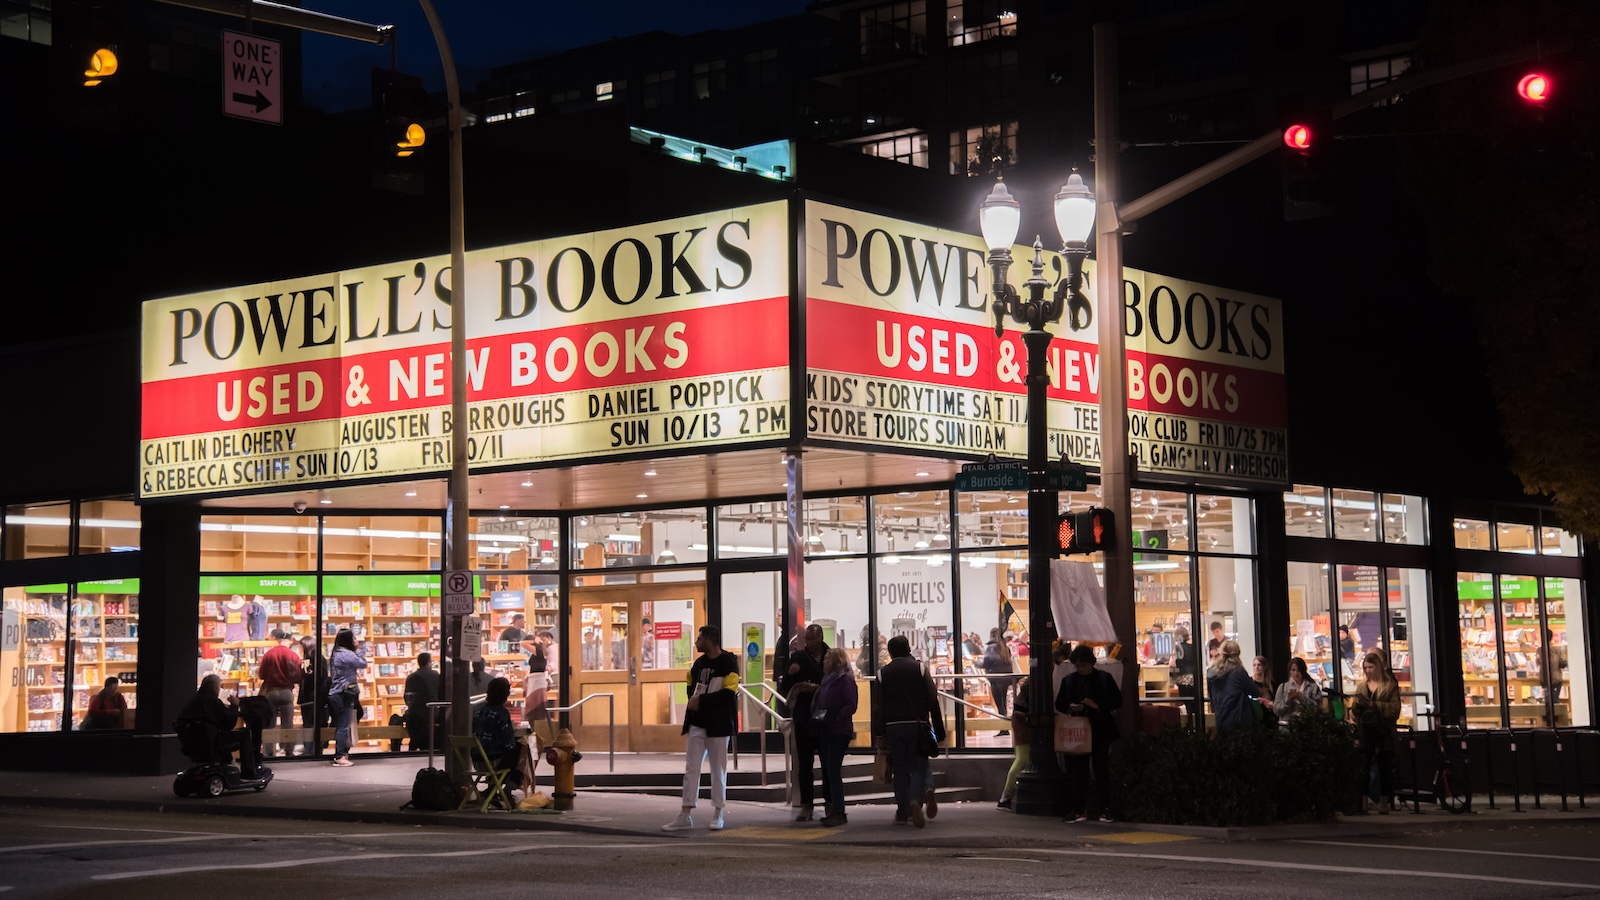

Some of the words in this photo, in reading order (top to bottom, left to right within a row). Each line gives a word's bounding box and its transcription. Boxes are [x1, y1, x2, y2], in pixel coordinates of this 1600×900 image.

[233, 39, 272, 65] ONE
[232, 61, 274, 87] WAY
[169, 261, 453, 367] POWELL'S
[495, 218, 753, 321] BOOKS
[820, 218, 1092, 330] POWE'S
[1123, 279, 1272, 360] BOOKS
[217, 371, 324, 422] USED
[345, 365, 372, 408] &
[389, 347, 490, 402] NEW
[511, 321, 689, 387] BOOKS
[876, 320, 979, 377] USED
[996, 340, 1022, 384] &
[1128, 360, 1239, 413] BOOKS
[588, 387, 659, 419] DANIEL
[670, 375, 764, 410] POPPICK
[807, 373, 858, 404] KIDS'
[867, 381, 965, 417] STORYTIME
[973, 393, 1003, 420] SAT
[341, 412, 430, 446] AUGUSTEN
[442, 397, 565, 434] BRROUGHS
[611, 419, 649, 447] SUN
[664, 412, 721, 443] 10/13
[807, 405, 867, 437] STORE
[874, 412, 929, 443] TOURS
[1074, 406, 1099, 432] TEE
[1127, 414, 1149, 438] OK
[1155, 417, 1187, 442] CLUB
[1199, 422, 1219, 446] FRI
[1223, 425, 1257, 450] 10/25
[1261, 430, 1286, 454] 7PM
[144, 440, 206, 466] CAITLIN
[213, 428, 296, 460] DELOHERY
[422, 439, 451, 466] FRI
[466, 434, 504, 460] 0/11
[1049, 432, 1100, 459] UNDEA
[1225, 452, 1287, 479] ANDERSON
[143, 471, 153, 492] &
[156, 466, 228, 492] REBECCA
[233, 456, 290, 484] SCHIFF
[296, 453, 327, 479] SUN
[333, 447, 379, 475] 10/13
[960, 480, 967, 488] W
[971, 474, 1014, 488] Burnside
[963, 464, 986, 472] PEARL
[988, 462, 1021, 470] DISTRICT
[259, 579, 278, 587] STAFF
[279, 579, 297, 587] PICKS
[451, 595, 467, 603] THIS
[880, 581, 945, 605] POWELL'S
[448, 603, 471, 612] BLOCK
